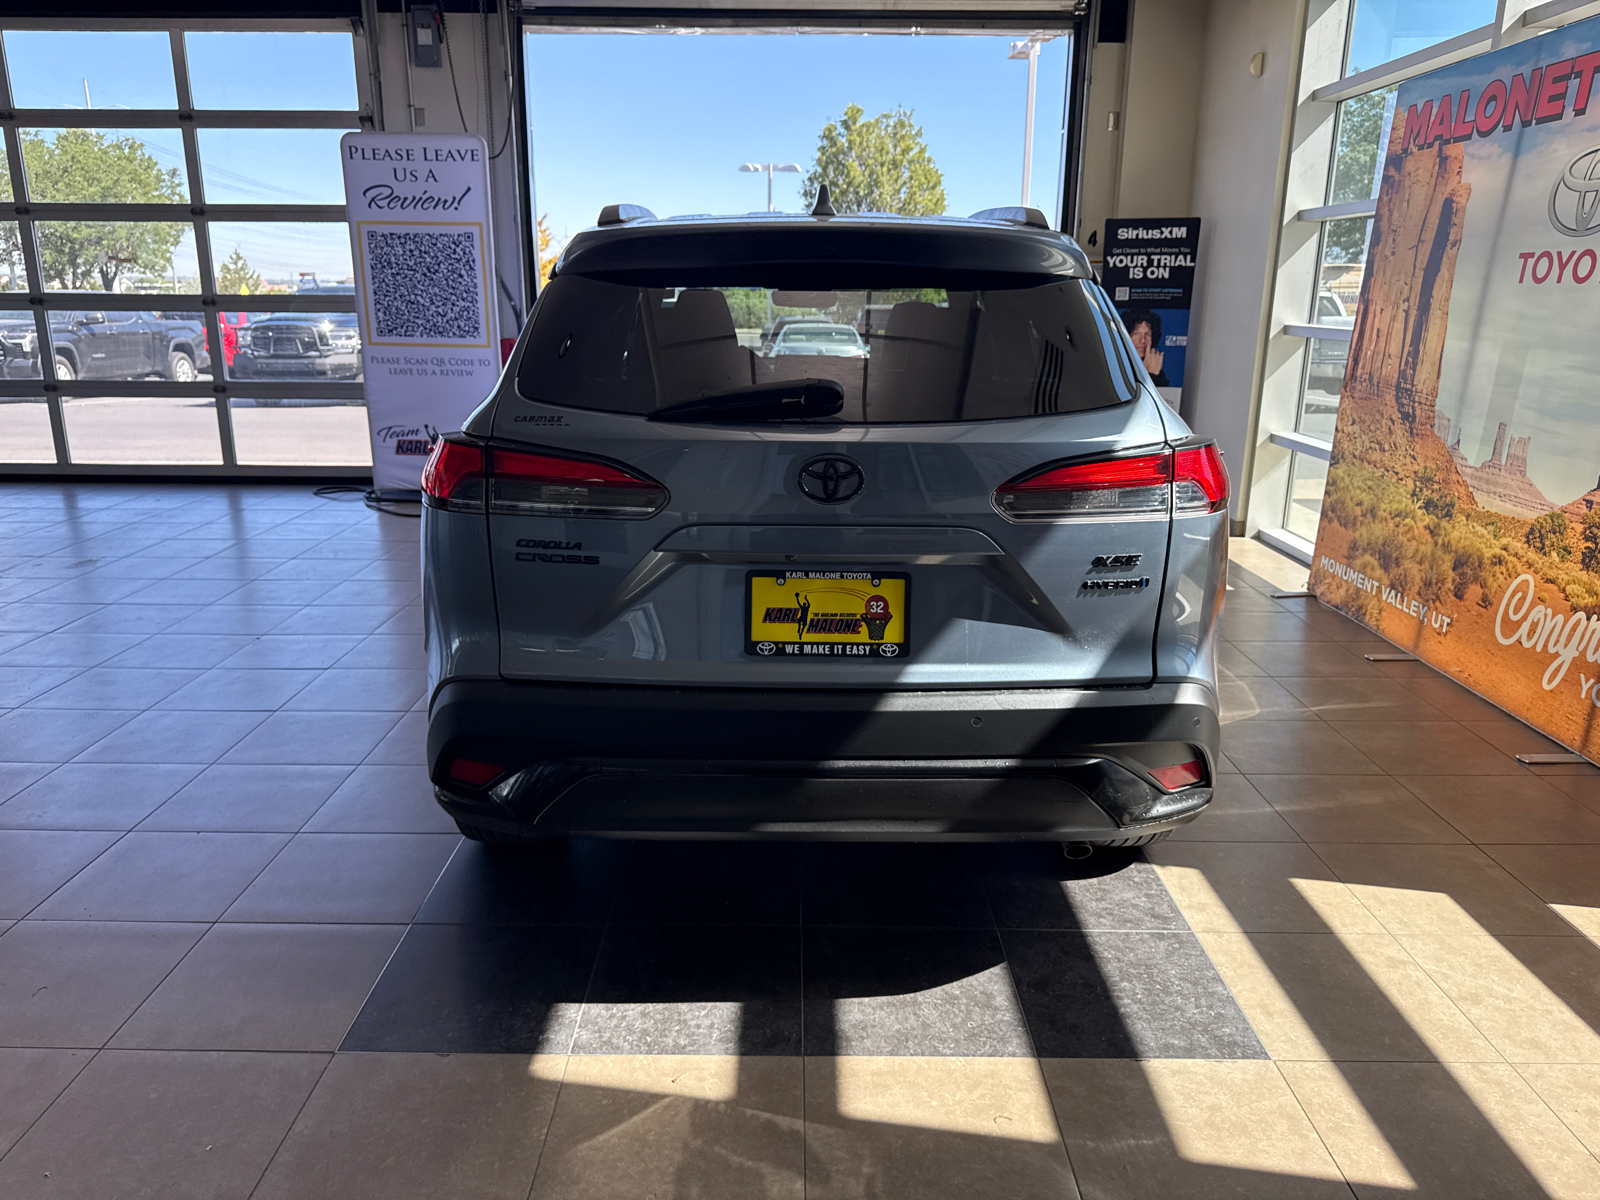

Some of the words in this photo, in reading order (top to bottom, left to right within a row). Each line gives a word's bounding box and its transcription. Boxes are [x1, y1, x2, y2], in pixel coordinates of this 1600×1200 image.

[424, 168, 439, 183] A
[362, 184, 472, 211] Review!
[1088, 230, 1097, 247] 4
[1117, 227, 1187, 240] SiriusXM
[1106, 255, 1148, 268] YOUR
[1150, 254, 1195, 267] TRIAL
[1129, 267, 1144, 279] IS
[1146, 267, 1170, 279] ON
[430, 357, 447, 367] QR
[477, 359, 491, 367] TO
[389, 367, 414, 376] LEAVE
[416, 368, 429, 376] US
[440, 369, 474, 377] REVIEW
[377, 424, 423, 443] Team
[395, 439, 431, 455] KARL
[515, 538, 583, 550] COROLLA
[515, 552, 600, 565] CROSS
[808, 572, 841, 580] MALONE
[1320, 555, 1379, 596] MONUMENT
[1381, 585, 1428, 626] VALLEY,
[1431, 613, 1451, 634] UT
[869, 601, 884, 613] 32
[762, 607, 800, 624] KARL
[805, 618, 862, 634] MALONE
[785, 644, 799, 654] WE
[803, 644, 830, 654] MAKE
[834, 645, 843, 654] IT
[846, 645, 871, 655] EASY
